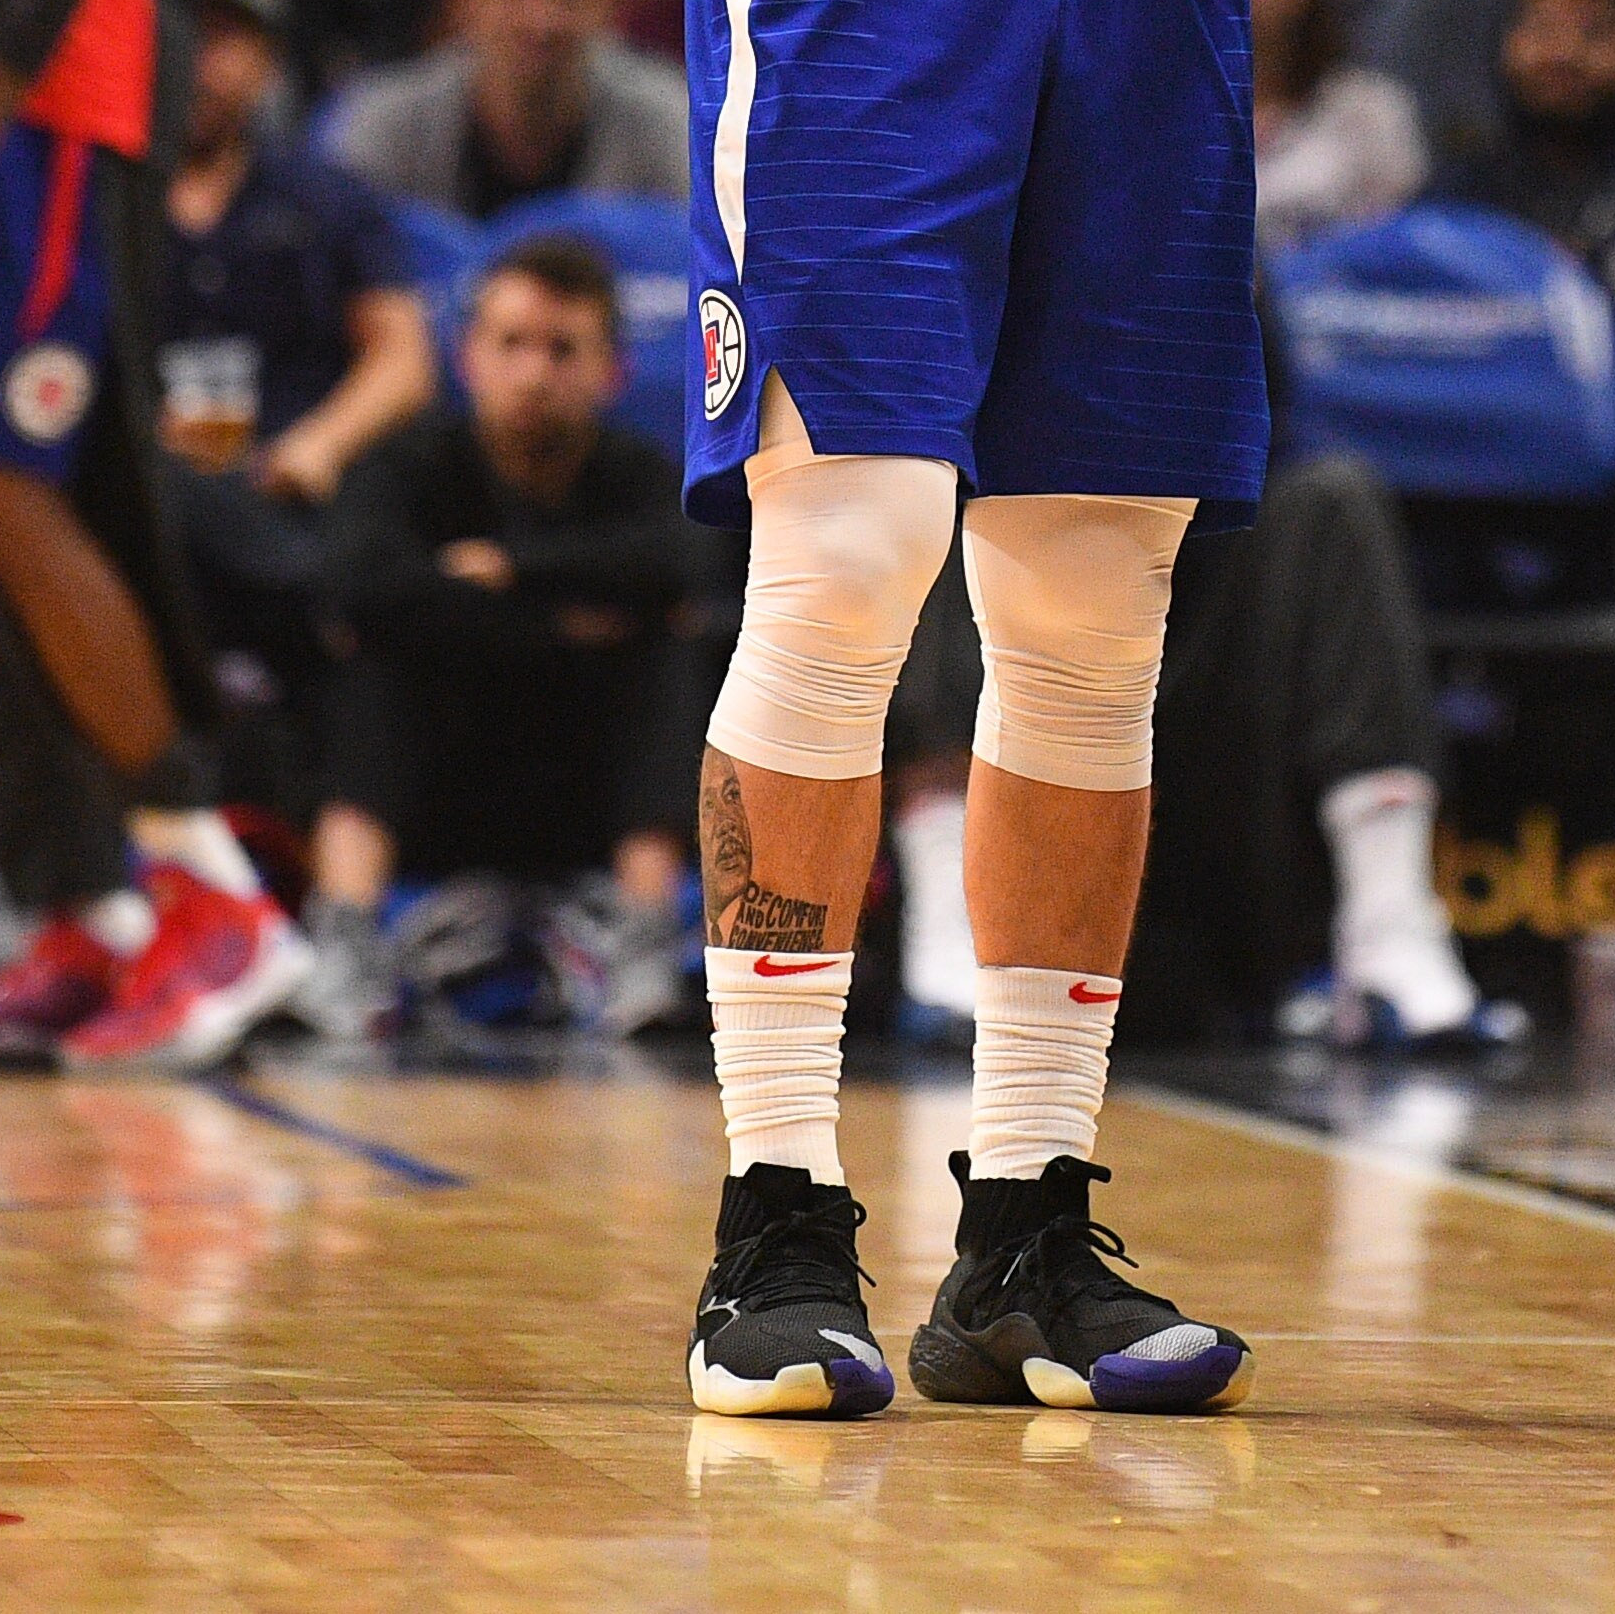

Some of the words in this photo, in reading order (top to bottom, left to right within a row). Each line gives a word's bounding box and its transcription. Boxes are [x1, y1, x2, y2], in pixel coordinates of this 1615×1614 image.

[736, 902, 765, 929] AND
[744, 880, 773, 907] OF
[766, 894, 828, 929] COMFORT
